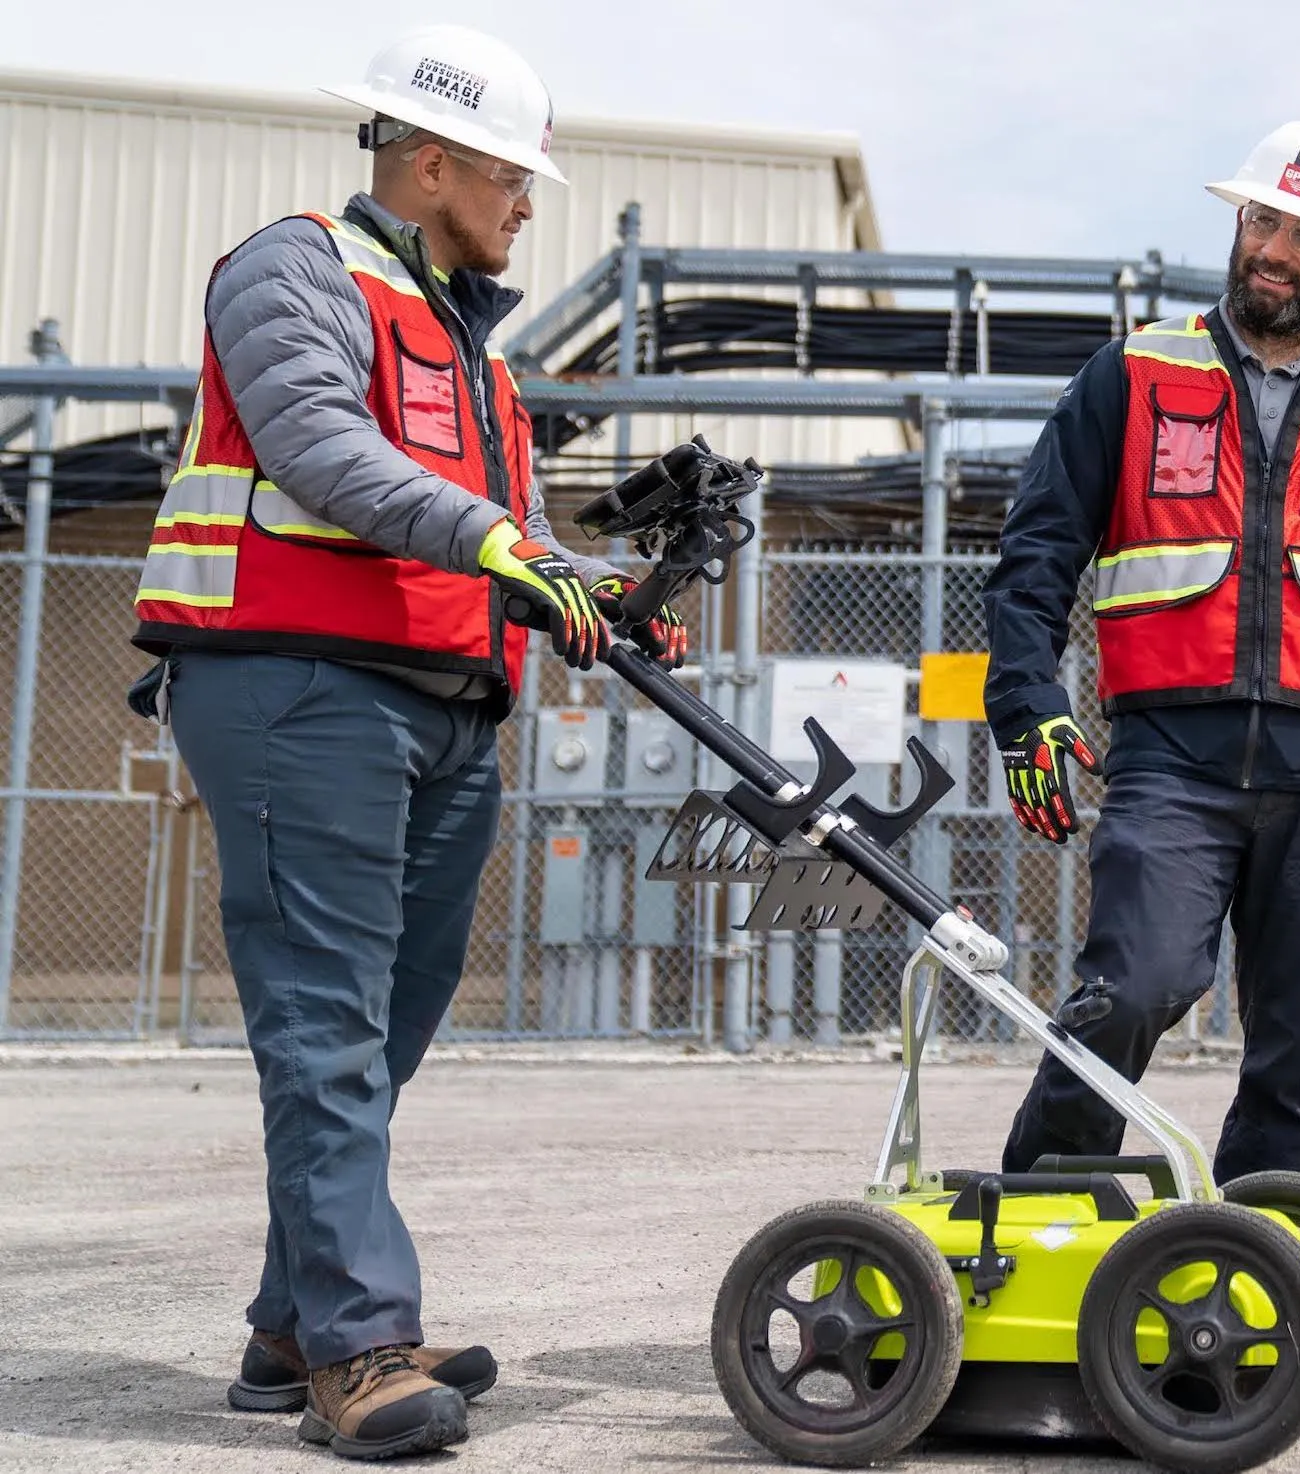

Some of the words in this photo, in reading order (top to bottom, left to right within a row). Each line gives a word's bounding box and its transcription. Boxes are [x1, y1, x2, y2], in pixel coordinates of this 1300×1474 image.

[414, 68, 483, 103] DAMAGE
[418, 61, 486, 92] SUBSURFACE
[410, 78, 479, 110] PREVENTION
